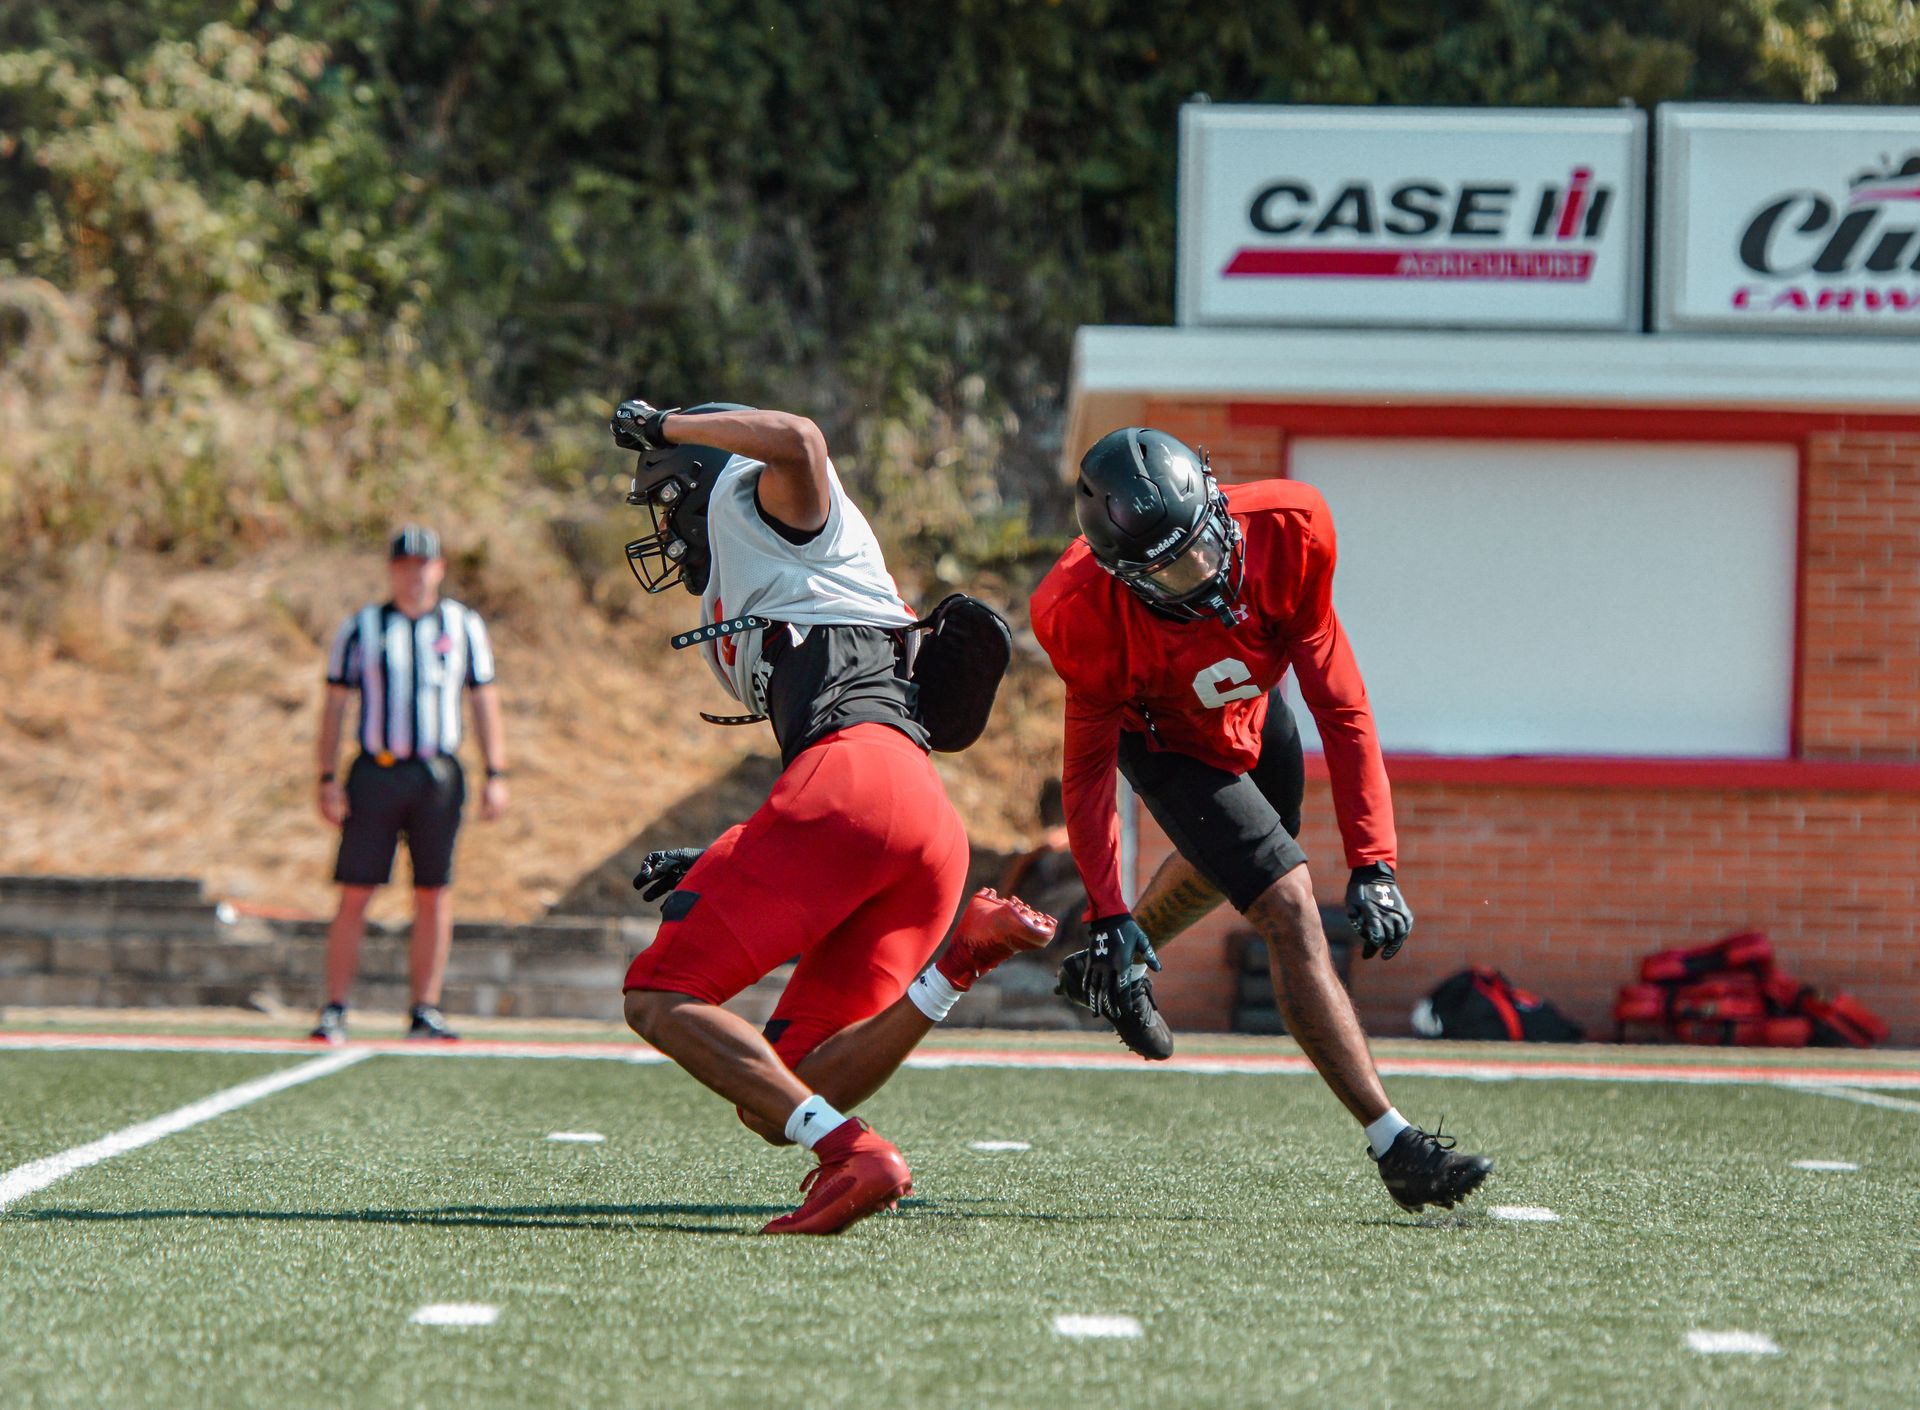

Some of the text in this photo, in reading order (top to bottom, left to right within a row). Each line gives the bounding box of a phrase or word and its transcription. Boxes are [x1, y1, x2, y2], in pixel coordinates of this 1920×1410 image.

[1248, 179, 1515, 236] CASE
[1399, 252, 1586, 279] AGRICULTURE
[1146, 530, 1182, 559] Riddell
